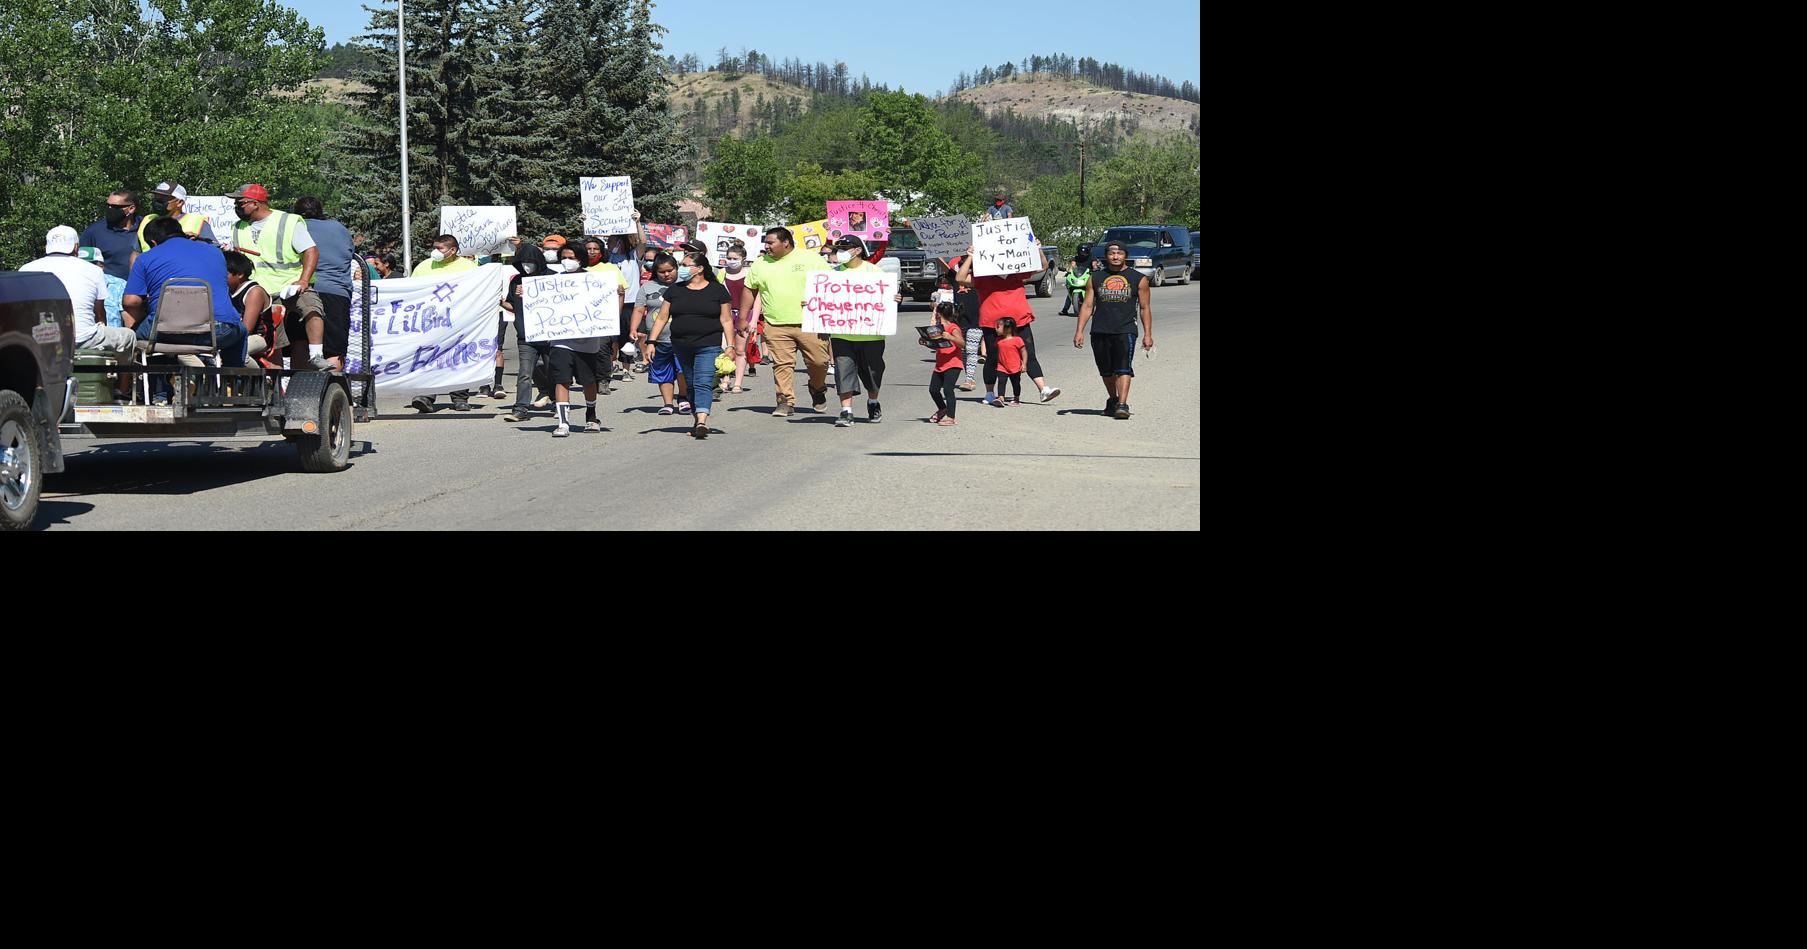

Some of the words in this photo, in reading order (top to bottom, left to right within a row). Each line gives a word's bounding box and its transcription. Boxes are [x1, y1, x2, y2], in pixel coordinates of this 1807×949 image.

[582, 177, 597, 191] We
[600, 178, 629, 192] Support
[997, 235, 1018, 245] for
[526, 278, 579, 299] Justice
[582, 274, 606, 291] for
[813, 273, 890, 294] Protect
[391, 299, 425, 314] For
[806, 296, 886, 315] Cheyenne
[530, 305, 613, 329] People
